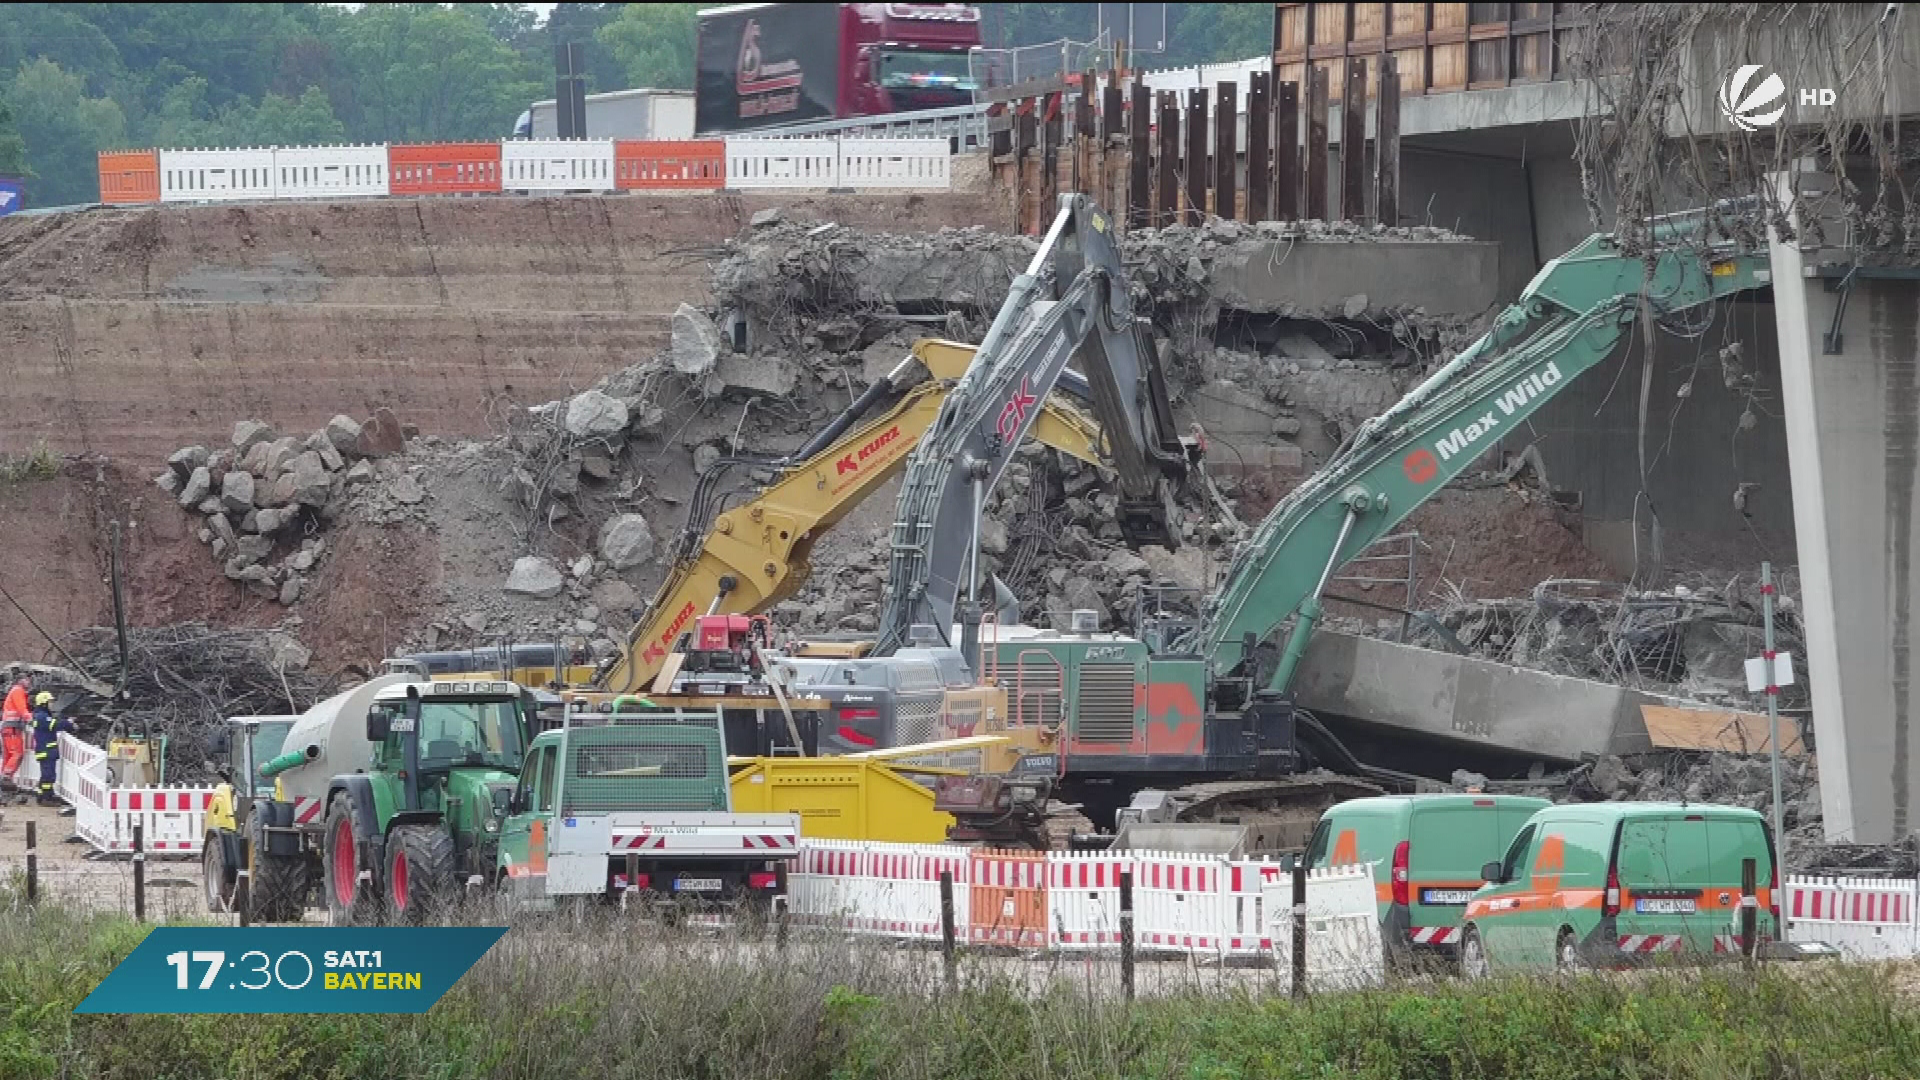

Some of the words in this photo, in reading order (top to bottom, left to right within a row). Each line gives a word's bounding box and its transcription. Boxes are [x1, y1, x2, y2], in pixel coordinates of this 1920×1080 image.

[1434, 411, 1499, 460] Max
[1494, 361, 1563, 416] Wild
[836, 453, 858, 475] K
[858, 425, 900, 461] KURZ
[661, 600, 696, 645] KURZ
[1025, 757, 1052, 768] VOLVO
[653, 825, 674, 834] Max
[676, 825, 699, 834] Wild
